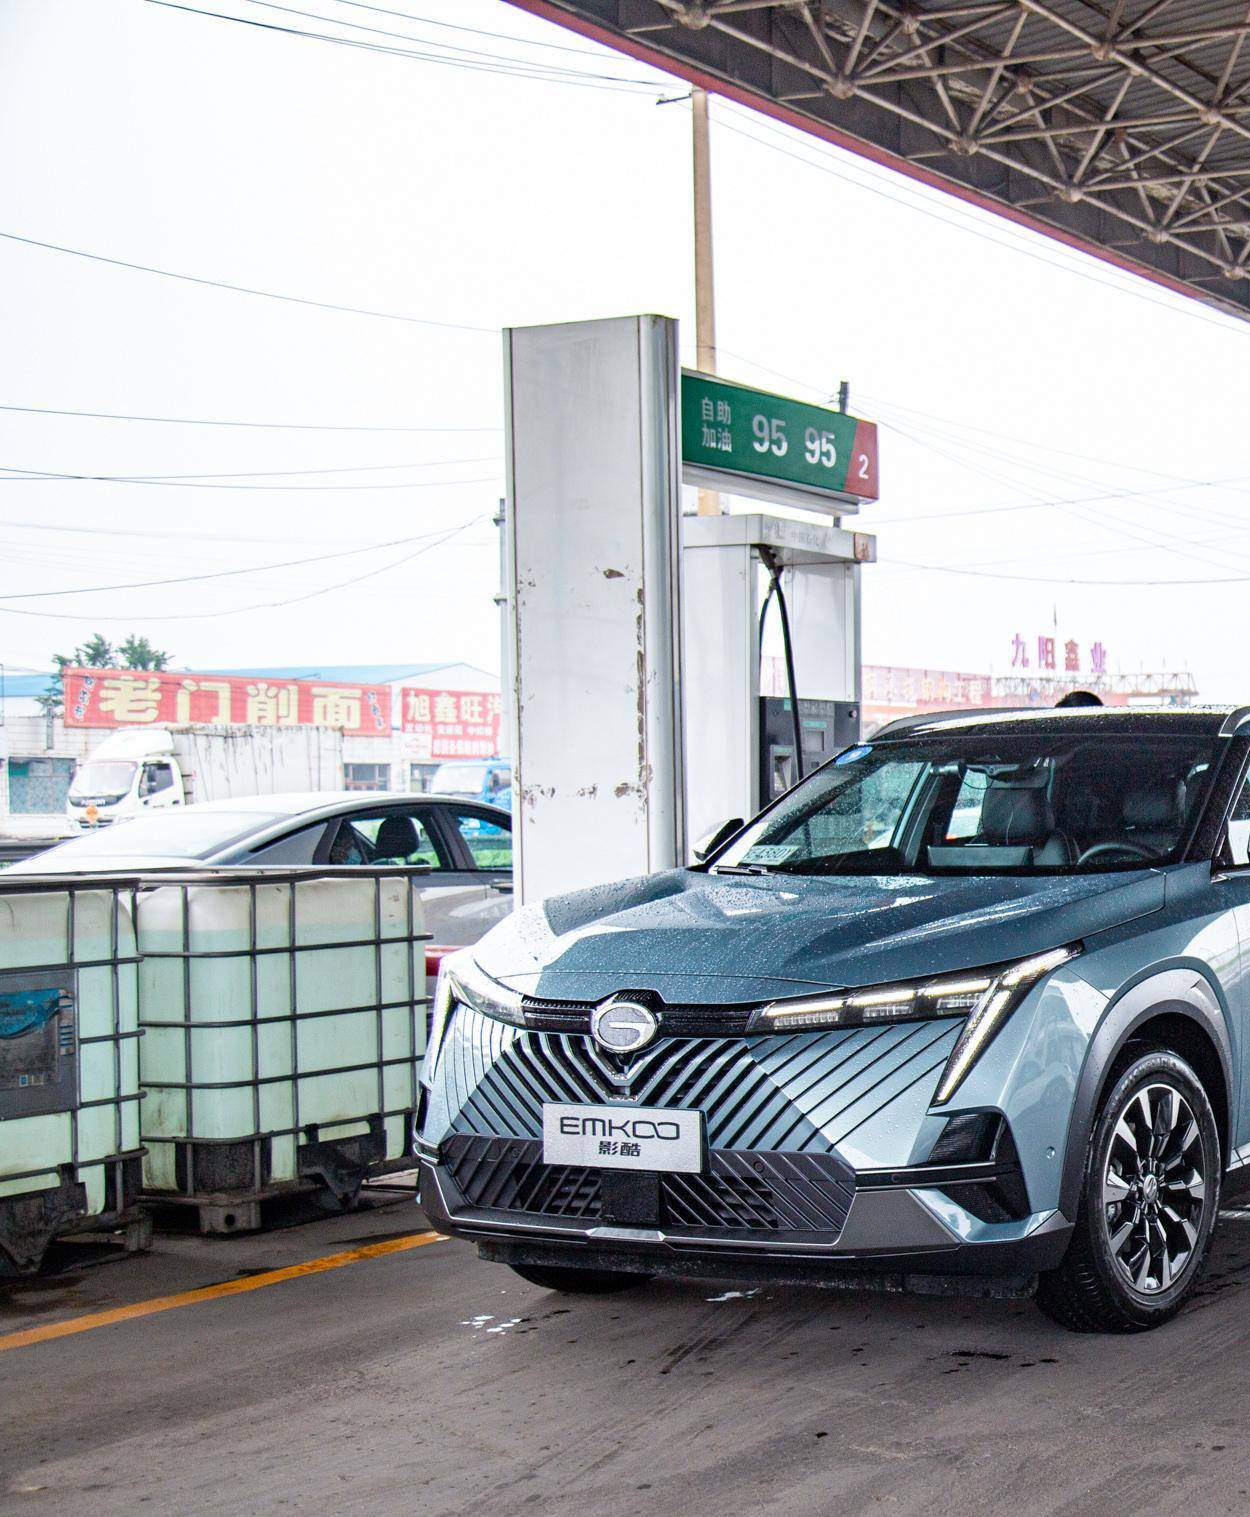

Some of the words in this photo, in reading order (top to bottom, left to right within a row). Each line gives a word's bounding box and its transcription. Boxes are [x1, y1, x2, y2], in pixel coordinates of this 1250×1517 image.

[701, 396, 731, 425] 自助
[702, 423, 732, 453] 加油
[752, 414, 788, 457] 95
[805, 427, 837, 468] 95
[858, 454, 869, 480] 2
[99, 675, 363, 729] 老门削面
[559, 1116, 681, 1141] EMKOO
[598, 1140, 642, 1157] 影酷
